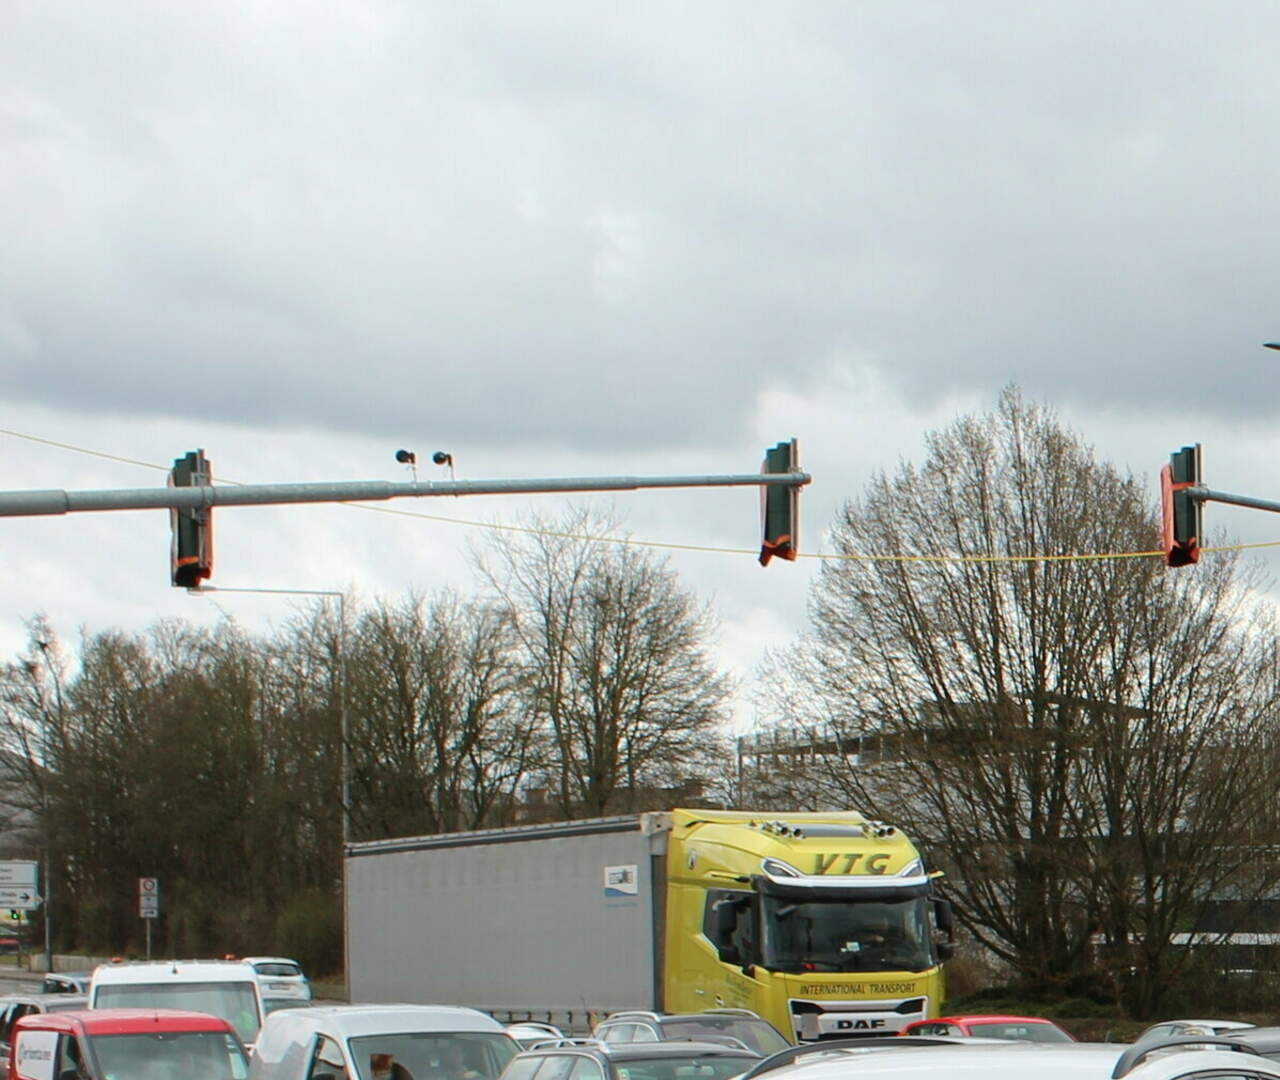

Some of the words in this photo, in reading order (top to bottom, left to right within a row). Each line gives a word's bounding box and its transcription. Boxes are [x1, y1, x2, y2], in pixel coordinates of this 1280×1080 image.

[813, 853, 892, 875] VTG
[800, 983, 866, 995] INTERNATIONAL
[869, 982, 916, 994] TRANSPORT
[836, 1019, 886, 1030] DAF
